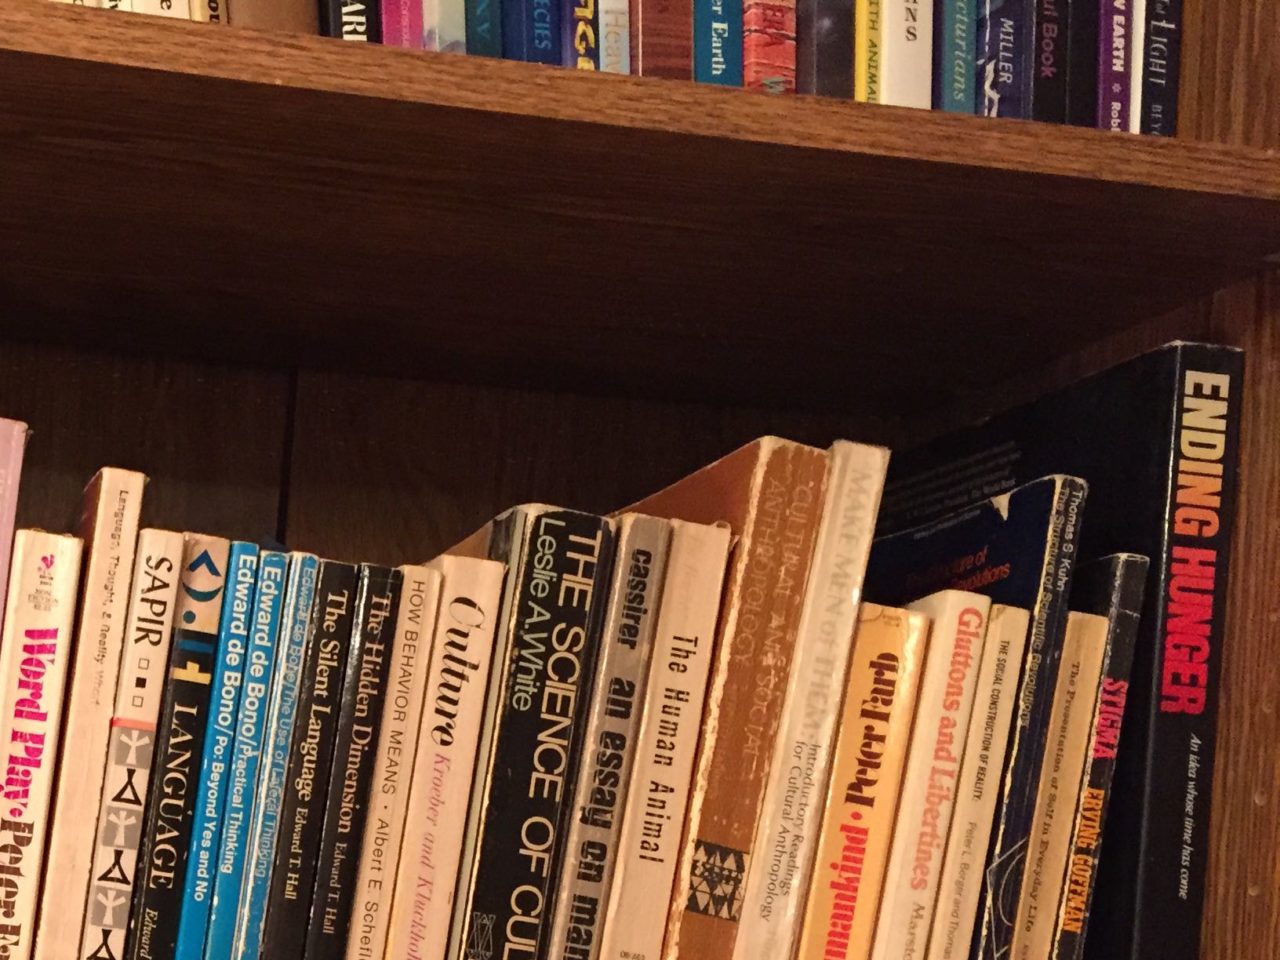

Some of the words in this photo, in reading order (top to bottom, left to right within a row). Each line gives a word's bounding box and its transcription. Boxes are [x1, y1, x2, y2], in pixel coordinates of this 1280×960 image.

[712, 23, 728, 75] Earth
[1000, 18, 1016, 84] MILLER
[1041, 23, 1054, 77] Book
[1174, 370, 1230, 538] ENDING
[230, 553, 256, 634] Edward
[529, 517, 566, 599] Leslie
[558, 530, 603, 612] THE
[1057, 559, 1073, 592] Kuhn
[135, 554, 173, 647] SAPIR
[253, 566, 281, 648] Edward
[325, 590, 348, 633] The
[367, 592, 392, 634] The
[617, 549, 653, 651] cassirer
[1161, 546, 1217, 715] HUNGER
[14, 628, 60, 722] Word
[313, 638, 341, 699] Silent
[353, 639, 384, 719] Hidden
[392, 631, 419, 723] BEHAVIOR
[431, 596, 486, 748] Culture
[667, 635, 699, 674] The
[942, 606, 984, 714] Gluttons
[527, 622, 586, 802] SCIENCE
[604, 677, 636, 721] an
[654, 687, 690, 767] Human
[294, 703, 332, 802] Language
[337, 722, 373, 834] Dimension
[382, 730, 400, 795] MEANS
[149, 702, 198, 890] LANGUAGE
[288, 807, 308, 860] Edward
[639, 781, 675, 864] Animal
[910, 763, 956, 891] Libertines
[1182, 782, 1198, 816] whose
[220, 809, 245, 874] Thinking
[371, 818, 389, 871] Albert
[518, 816, 554, 878] OF
[781, 837, 805, 896] Readings
